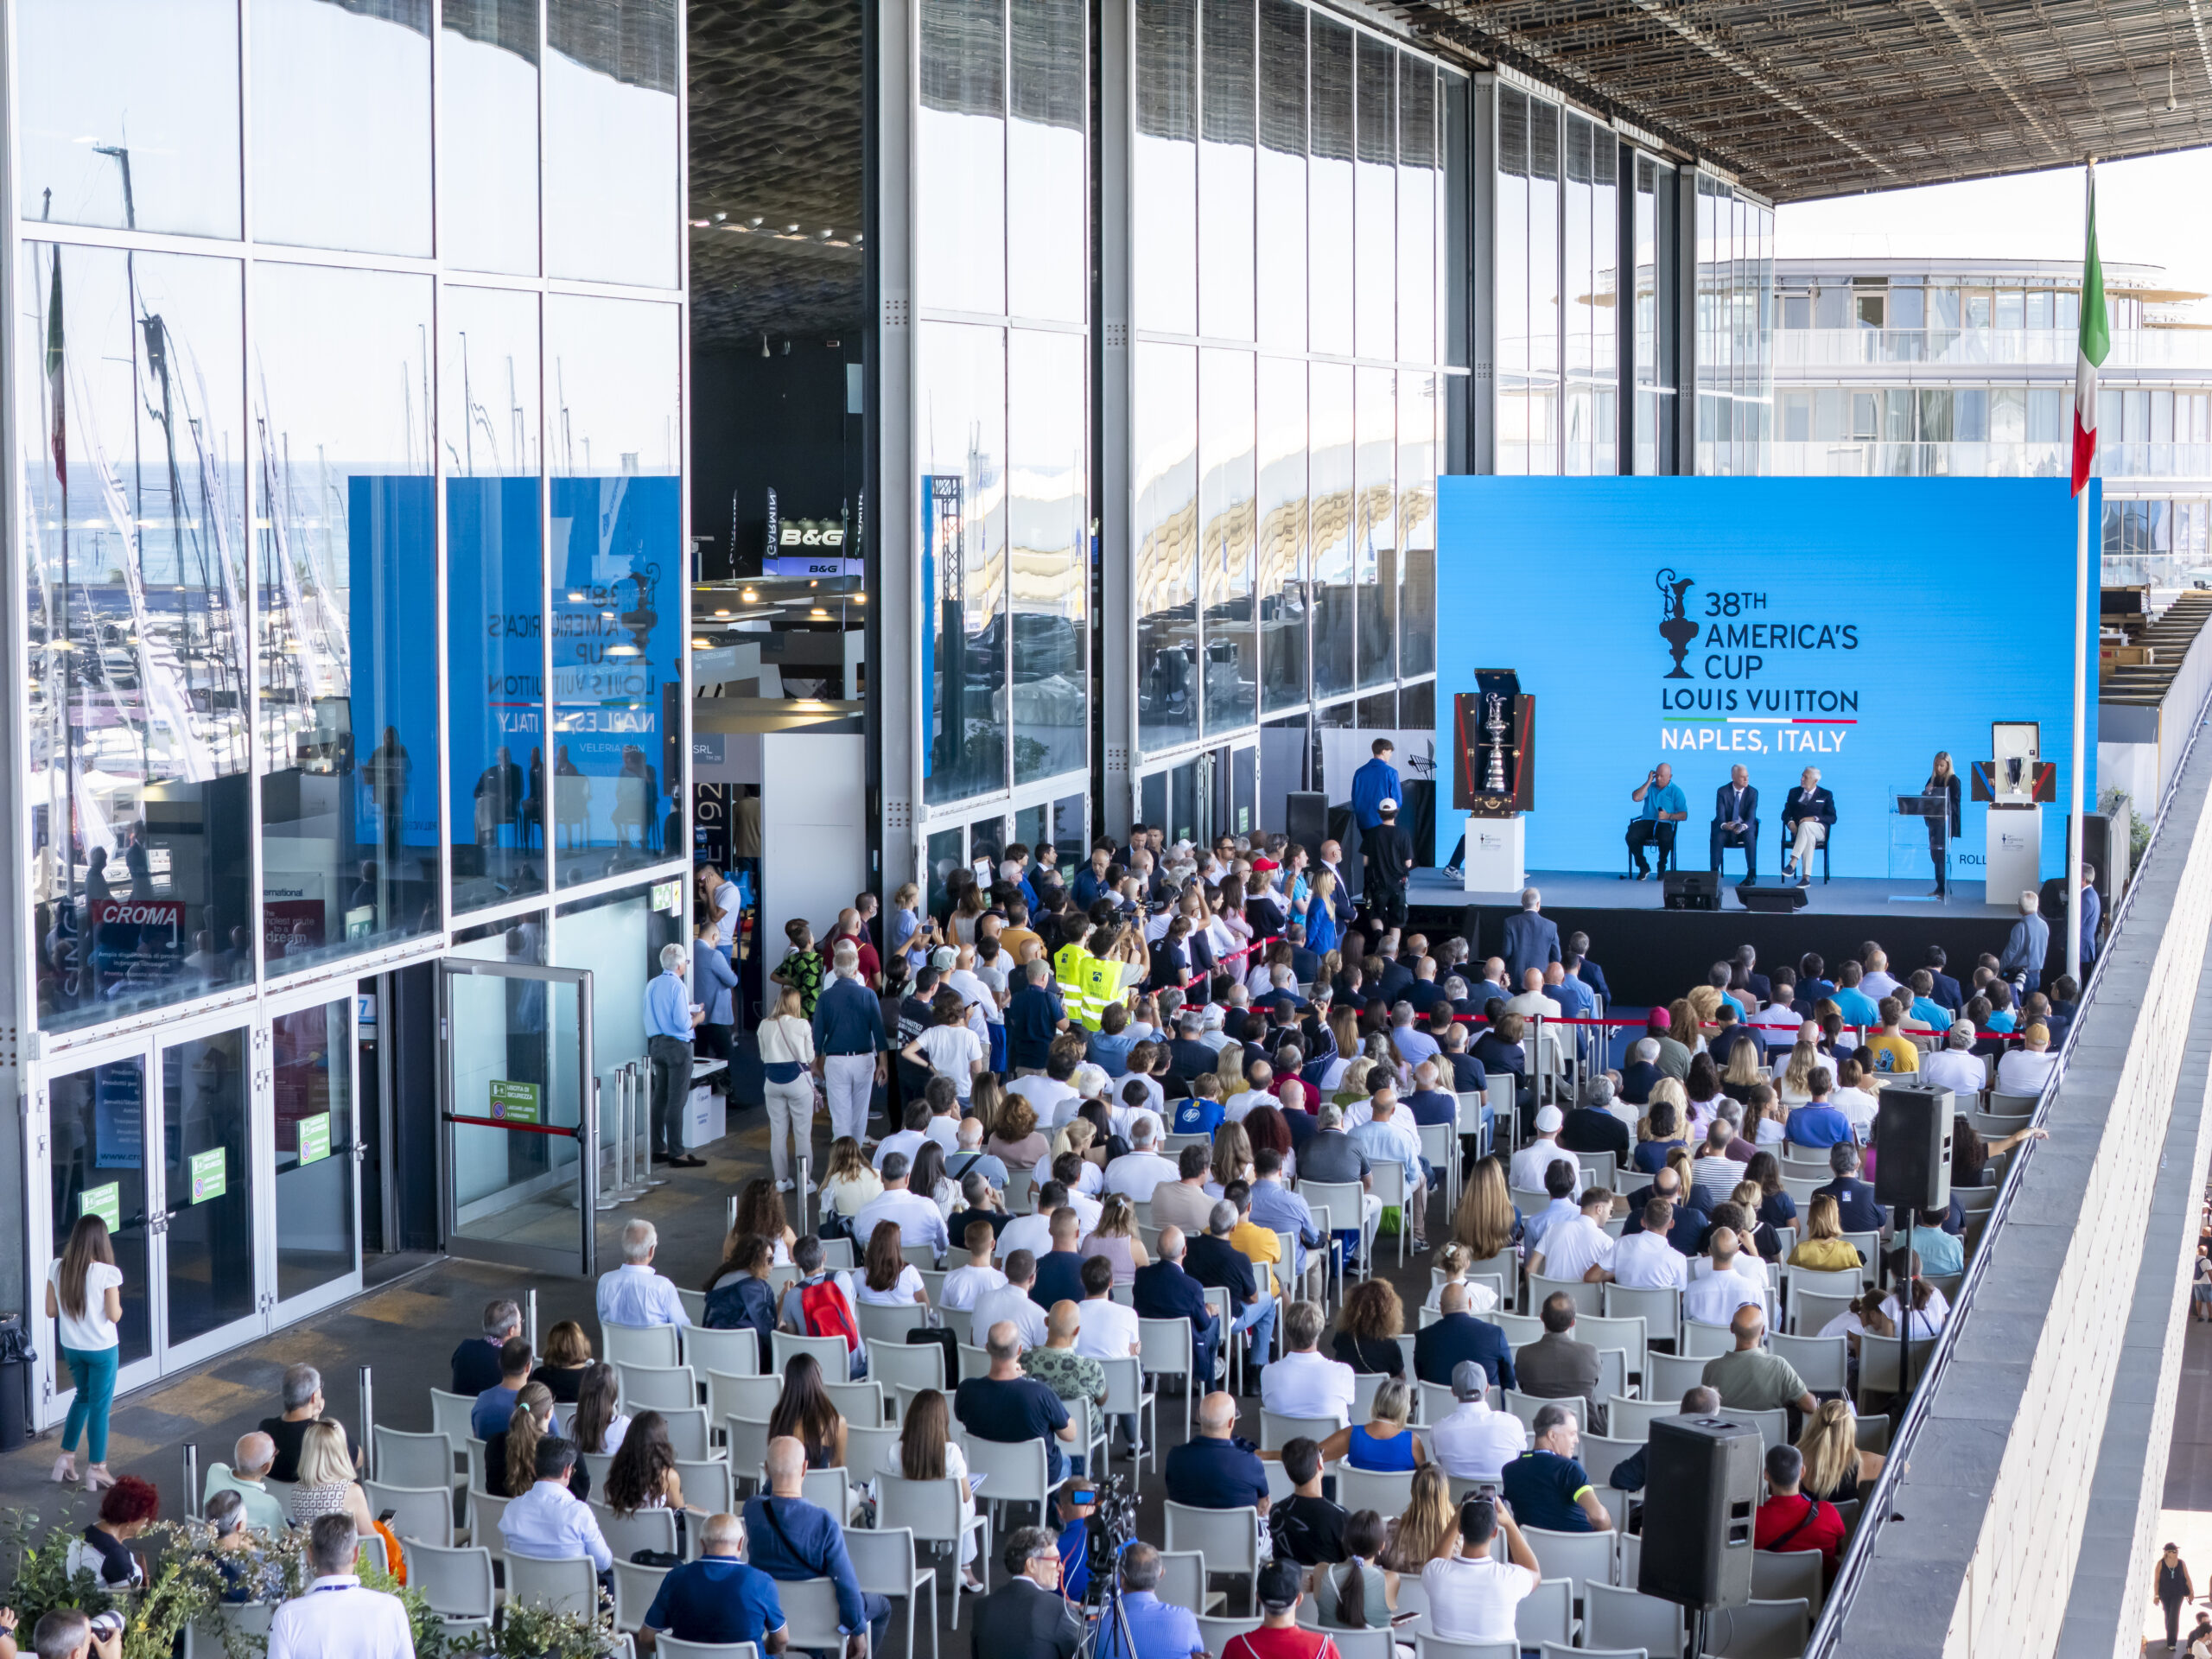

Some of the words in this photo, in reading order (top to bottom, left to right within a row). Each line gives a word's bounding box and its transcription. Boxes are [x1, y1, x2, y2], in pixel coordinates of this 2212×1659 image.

[780, 529, 844, 546] B&G
[1705, 592, 1767, 617] 38TH
[1704, 624, 1859, 650] AMERICA'S
[1704, 655, 1763, 680] CUP
[1662, 689, 1738, 711] LOUIS
[1747, 690, 1859, 713] VUITTON
[579, 743, 621, 753] VELERIA
[624, 744, 645, 753] SAN
[692, 745, 713, 754] SRL
[1662, 728, 1769, 753] NAPLES,
[1777, 730, 1847, 753] ITALY
[265, 931, 307, 944] dream
